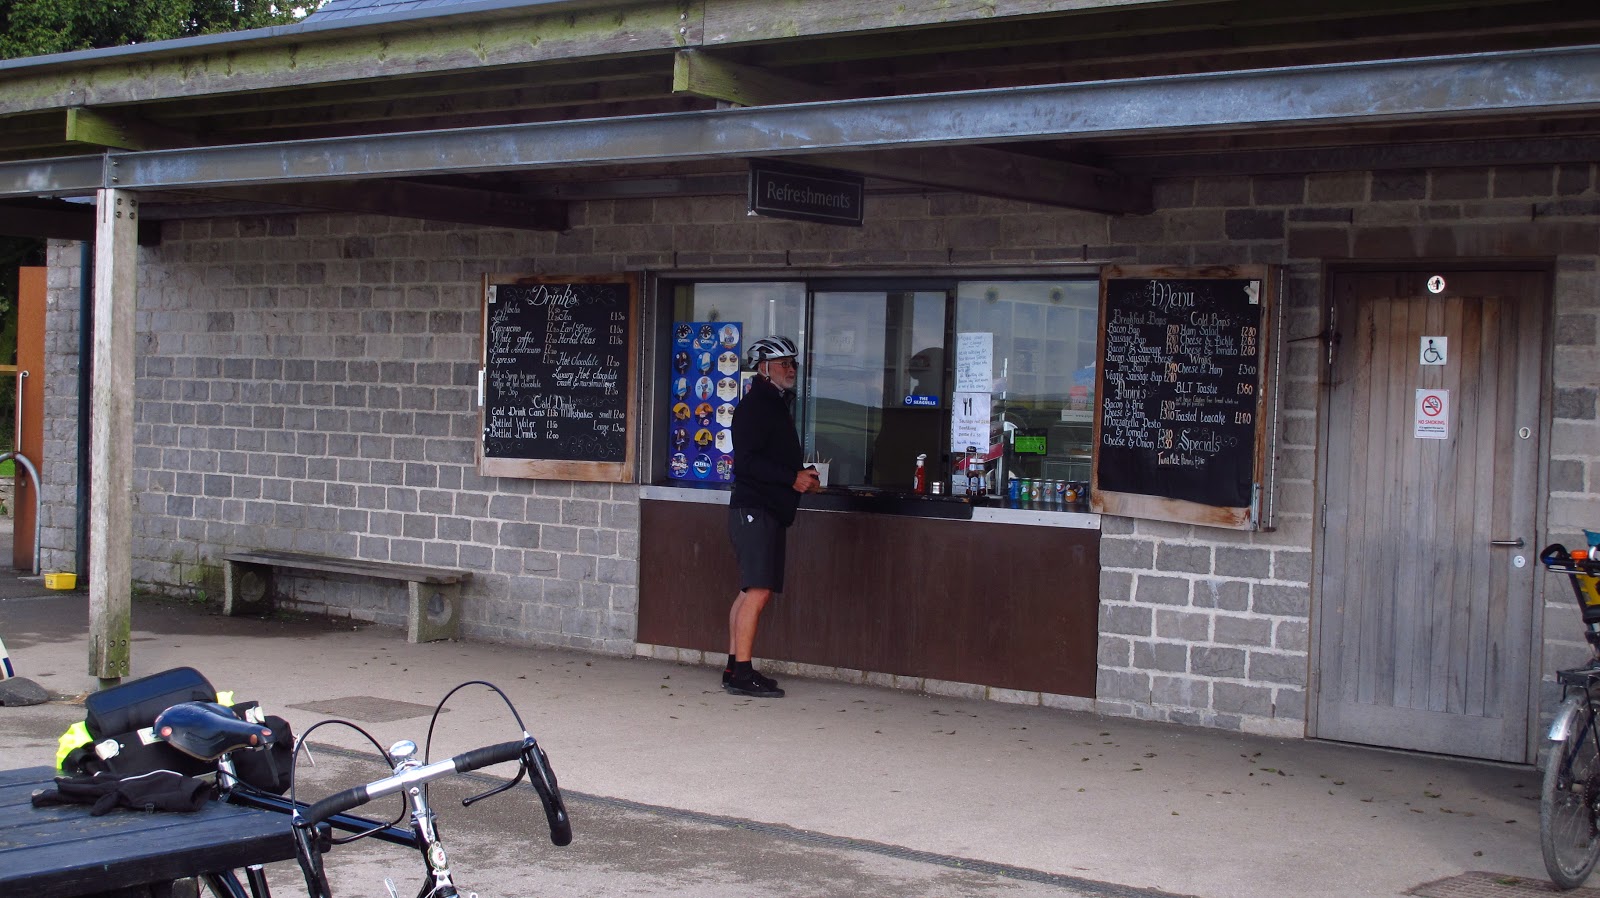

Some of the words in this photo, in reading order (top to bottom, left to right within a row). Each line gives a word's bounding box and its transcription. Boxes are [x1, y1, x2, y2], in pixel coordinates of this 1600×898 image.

[767, 181, 850, 208] Refreshments
[527, 284, 579, 309] Drinks
[1150, 280, 1195, 313] Menu
[559, 310, 572, 321] Tea
[1112, 309, 1145, 325] Breakfast
[1146, 311, 1167, 327] Baps
[1190, 311, 1209, 326] Cold
[1210, 312, 1231, 330] Baps
[560, 322, 575, 333] Earl
[575, 323, 596, 337] Grey
[1107, 322, 1127, 334] Bacon
[1127, 323, 1141, 336] Bap
[1180, 324, 1197, 337] Ham
[1199, 324, 1220, 336] Salad
[1107, 333, 1132, 347] Sausage
[1133, 333, 1147, 345] Bap
[1180, 334, 1202, 346] Cheese
[1214, 336, 1234, 348] Pickle
[1106, 342, 1126, 354] Bacon
[1179, 344, 1202, 356] Cheese
[1214, 344, 1238, 356] Tomato
[491, 352, 517, 368] Espresso
[1106, 351, 1126, 363] Bacon
[1189, 354, 1212, 365] Wraps
[551, 365, 574, 380] Luxury
[1177, 362, 1199, 374] Cheese
[1208, 364, 1223, 378] Ham
[1126, 371, 1149, 386] Sausage
[1150, 371, 1163, 387] Bap
[533, 394, 551, 409] Cold
[552, 394, 577, 411] Drinks
[1103, 398, 1124, 409] Bacon
[491, 406, 505, 416] Cold
[507, 406, 527, 416] Drink
[528, 407, 546, 417] Cans
[1104, 408, 1123, 417] Cheese
[1132, 408, 1145, 419] Ham
[1175, 408, 1198, 422] Toasted
[516, 417, 536, 428] Water
[1142, 417, 1162, 431] Pesto
[514, 427, 538, 439] Drinks
[1125, 426, 1149, 438] Tomato
[1103, 434, 1125, 447] Cheese
[1135, 437, 1155, 450] Onion
[1178, 428, 1221, 455] Specials
